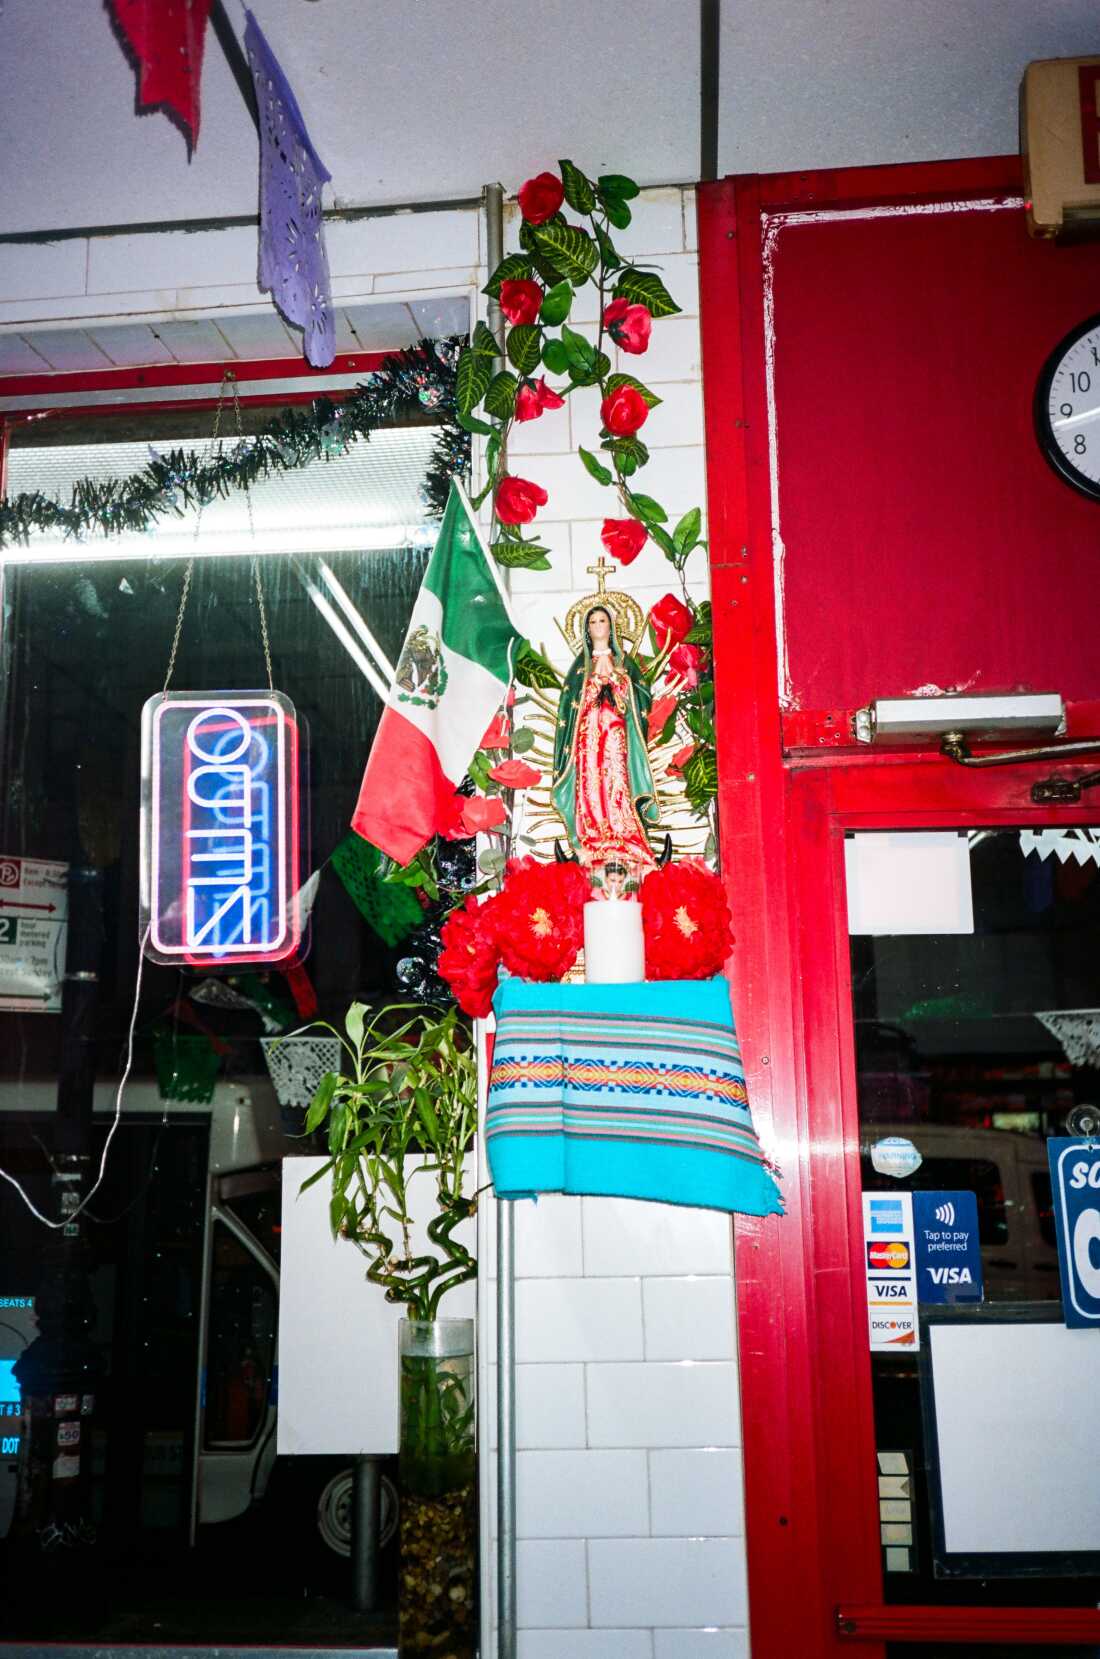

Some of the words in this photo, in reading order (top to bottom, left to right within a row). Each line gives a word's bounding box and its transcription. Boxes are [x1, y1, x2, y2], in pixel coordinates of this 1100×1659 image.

[1070, 371, 1091, 393] 10
[1060, 403, 1073, 418] 9
[1074, 434, 1087, 454] 8
[0, 918, 10, 942] 2
[924, 1230, 941, 1242] Tap
[941, 1231, 952, 1240] to
[953, 1232, 969, 1243] pay
[928, 1241, 968, 1253] preferred
[926, 1267, 972, 1284] VISA
[875, 1285, 908, 1297] VISA
[872, 1321, 912, 1330] DISCOVER
